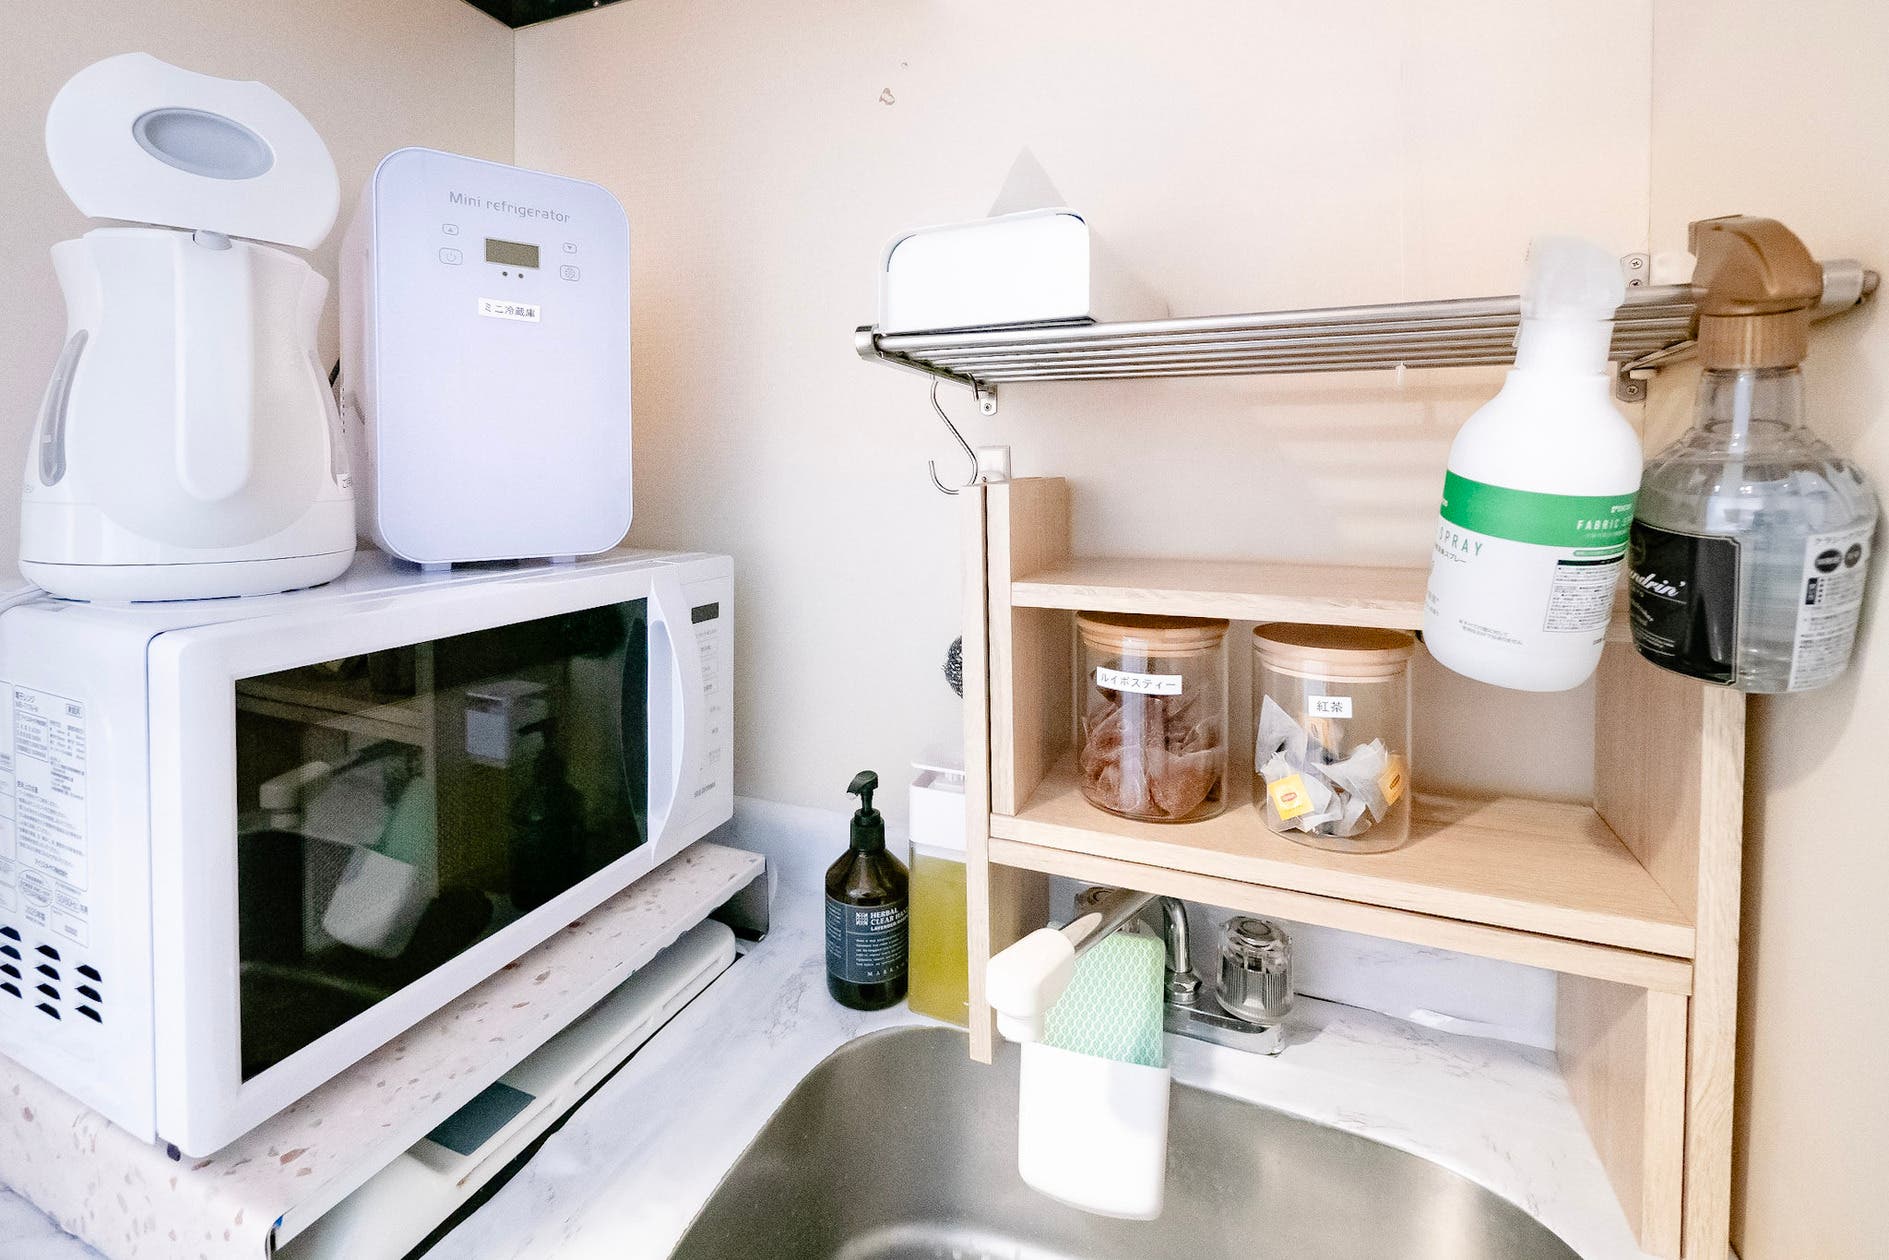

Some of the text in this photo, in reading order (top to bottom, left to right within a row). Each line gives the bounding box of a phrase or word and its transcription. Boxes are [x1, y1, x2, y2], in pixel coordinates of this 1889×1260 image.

[449, 191, 571, 223] Mini refrigerator
[484, 302, 536, 318] ミニ冷蔵庫
[1576, 518, 1620, 530] FABRIC
[1440, 526, 1483, 557] SPRAY
[1100, 671, 1177, 690] ルイボスティー
[1316, 700, 1344, 713] 紅茶
